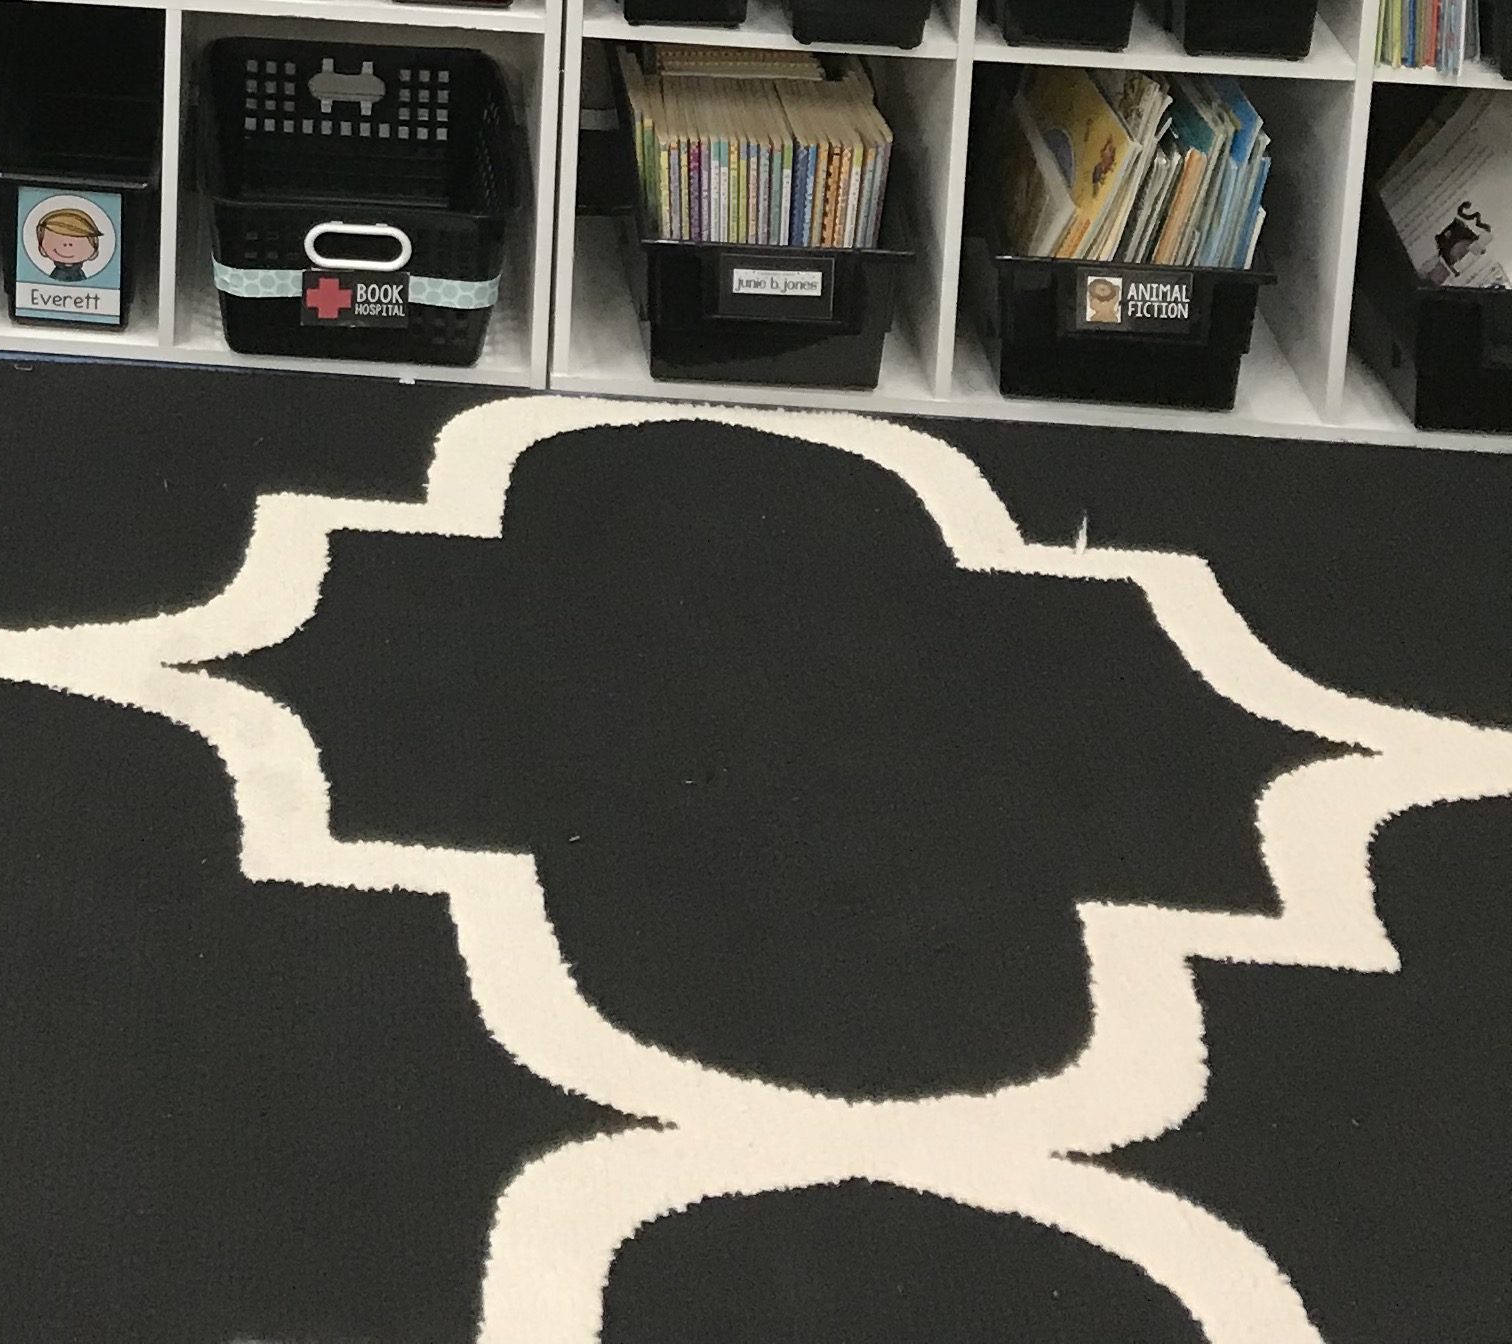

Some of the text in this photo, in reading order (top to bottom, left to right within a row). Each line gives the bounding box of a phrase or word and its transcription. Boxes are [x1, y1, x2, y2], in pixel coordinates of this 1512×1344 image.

[30, 289, 100, 311] Everett
[355, 283, 405, 305] BOOK
[1126, 282, 1190, 302] ANIMAL
[355, 302, 406, 318] HOSPITAL
[1127, 301, 1189, 319] FICTION
